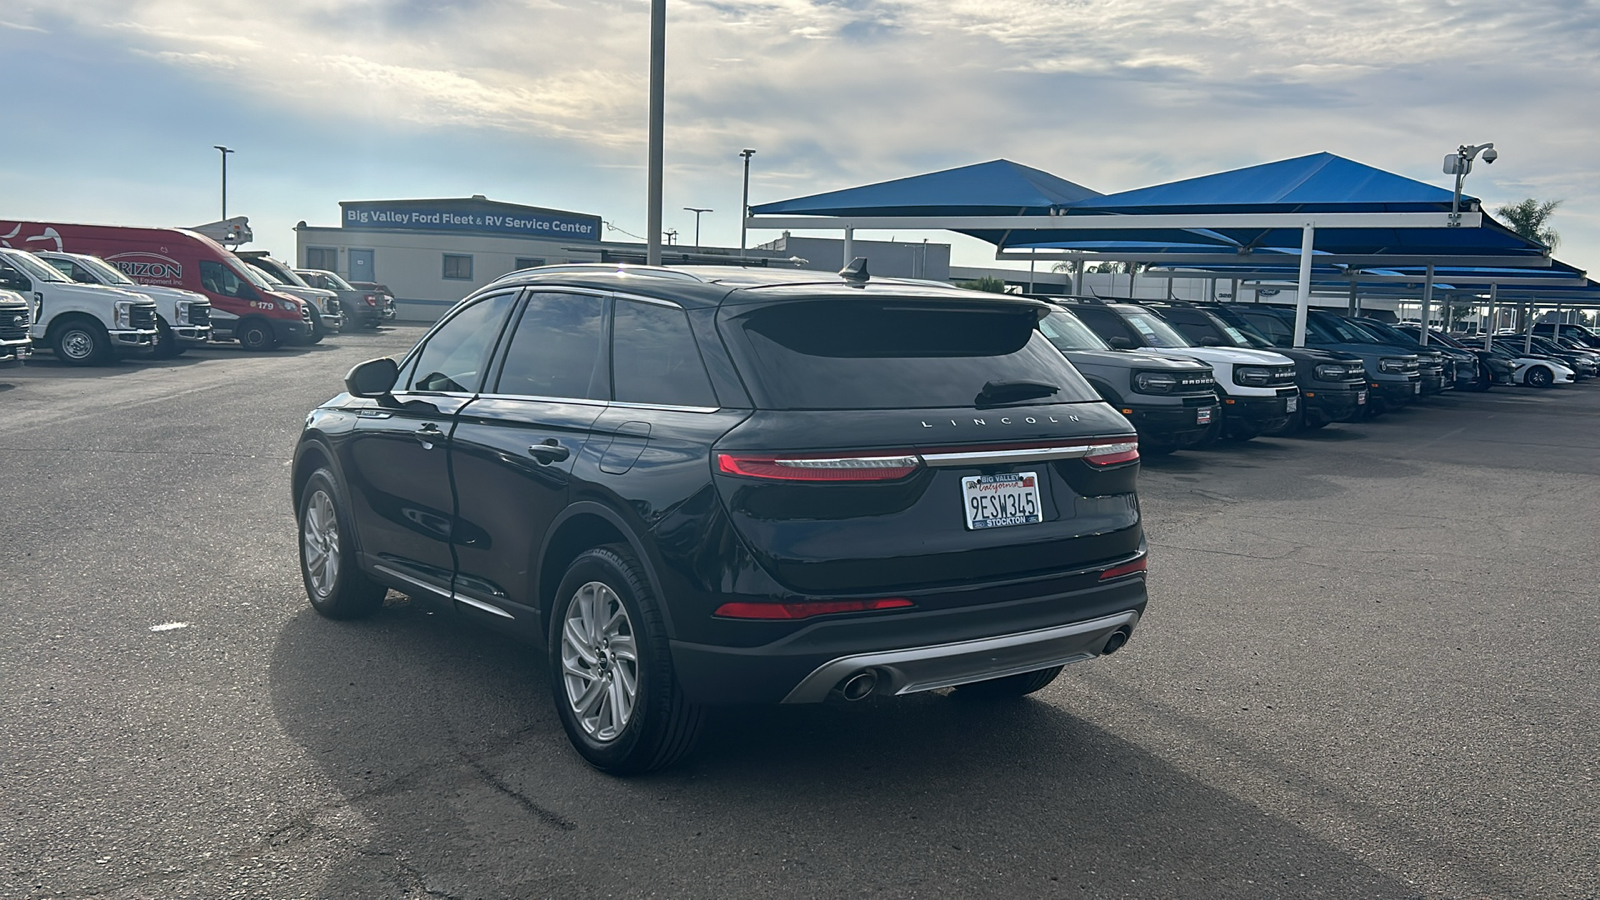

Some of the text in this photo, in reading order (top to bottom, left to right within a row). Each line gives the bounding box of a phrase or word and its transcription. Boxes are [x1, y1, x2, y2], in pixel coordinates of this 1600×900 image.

[347, 210, 592, 234] Big Valley Ford Fleet & RV Service Center
[257, 301, 274, 311] 179
[921, 414, 1080, 428] LINCOLN
[995, 474, 1019, 482] VALLEY
[970, 492, 1036, 520] 9ESW345
[986, 516, 1026, 527] STOCKTON
